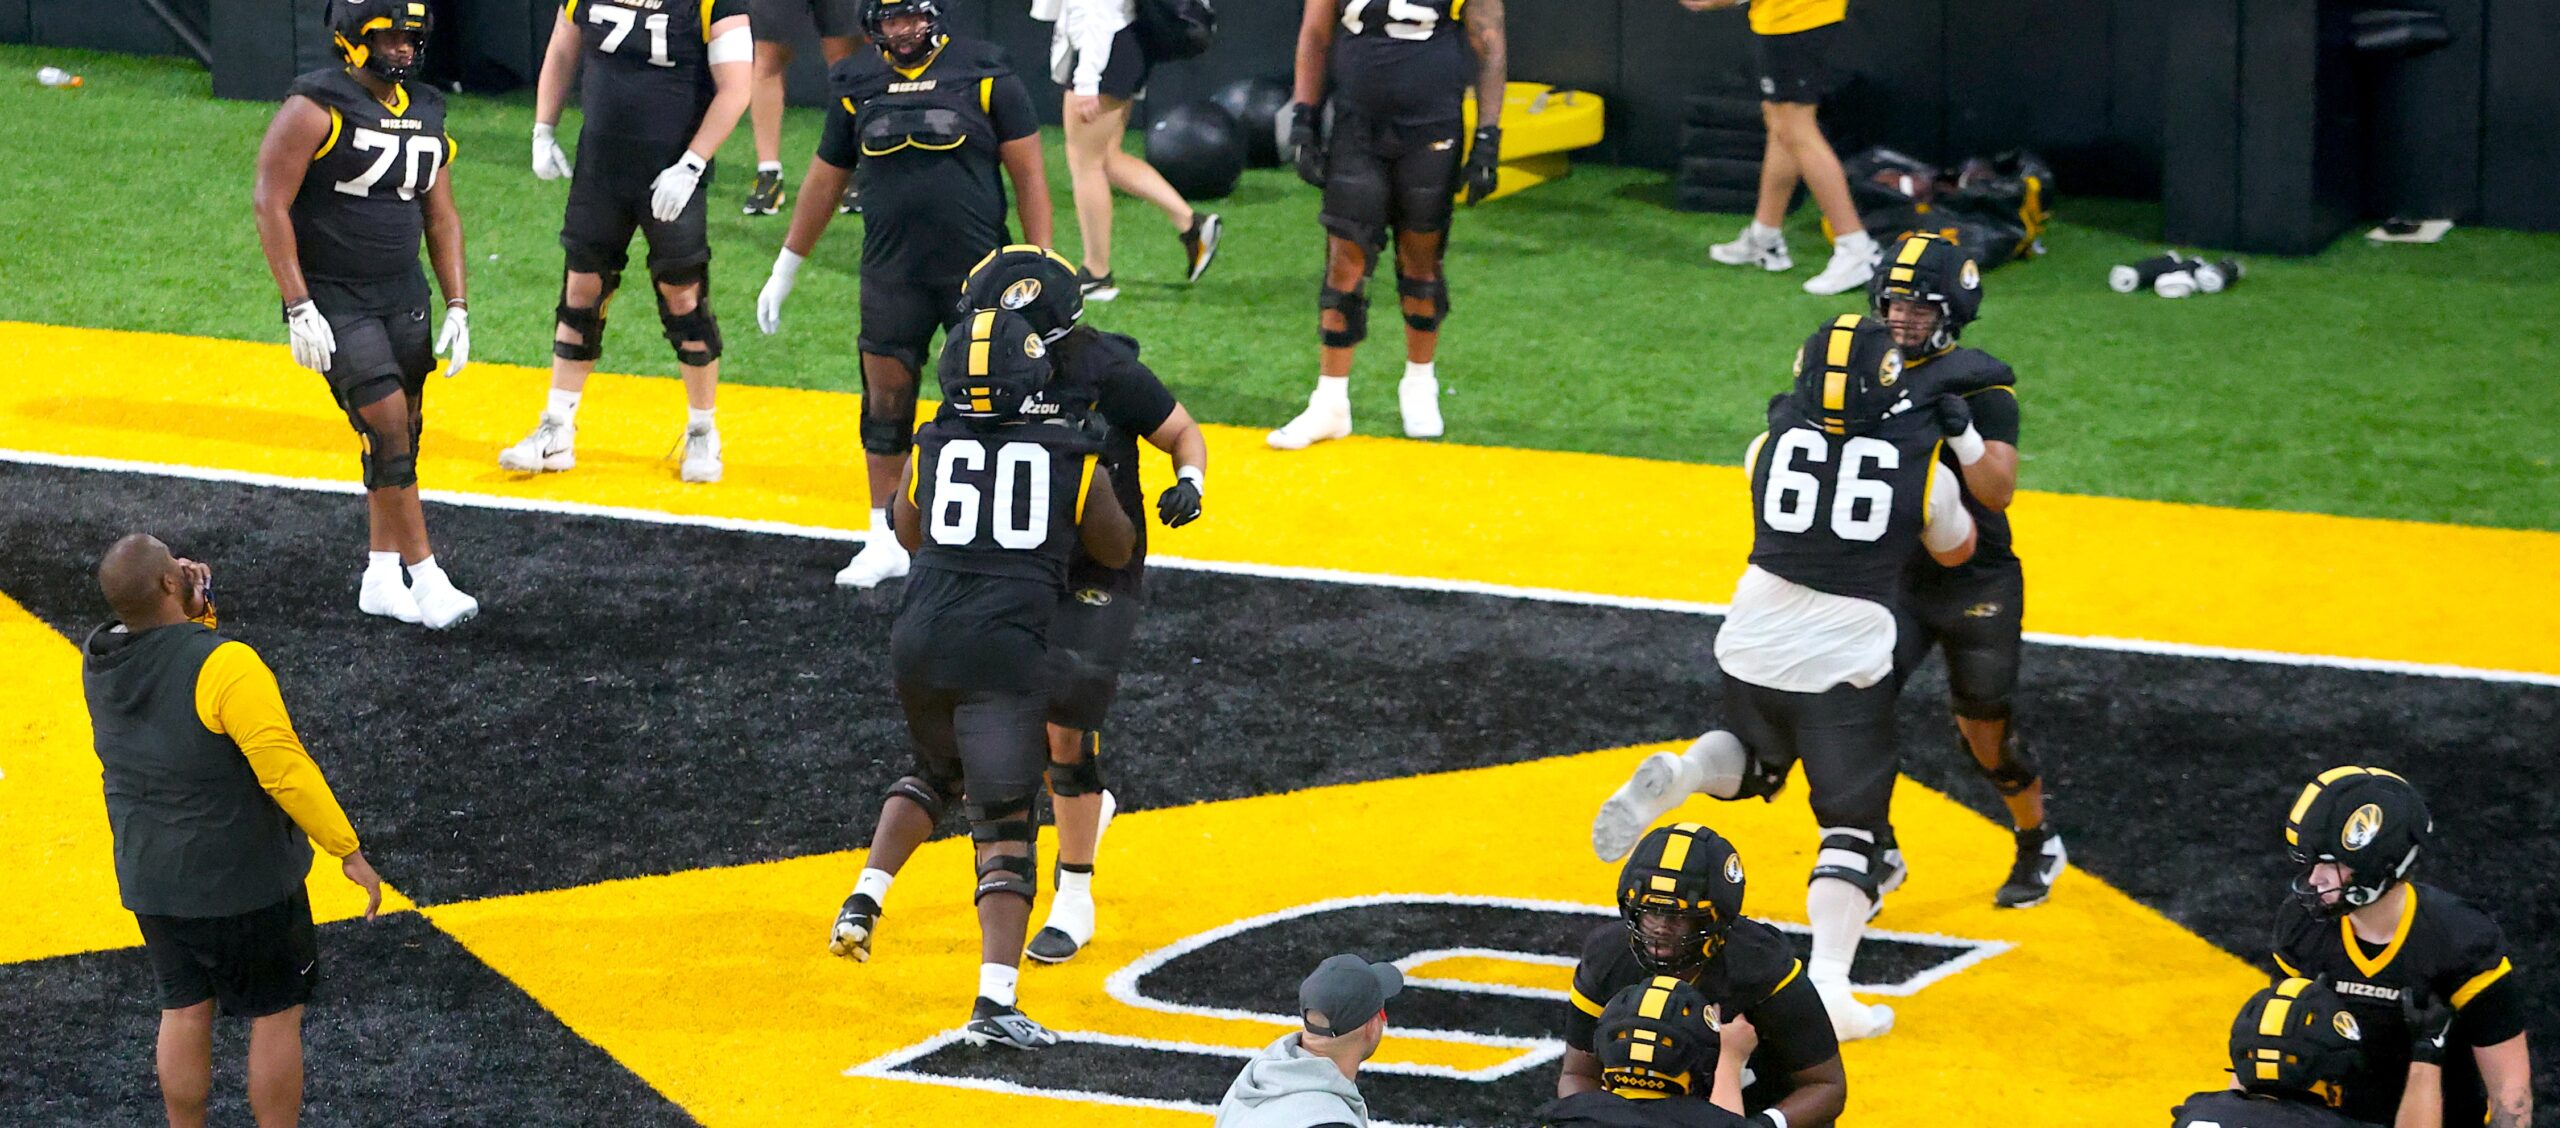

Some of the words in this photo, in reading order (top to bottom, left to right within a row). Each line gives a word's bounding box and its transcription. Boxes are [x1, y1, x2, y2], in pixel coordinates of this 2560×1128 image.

[588, 3, 676, 67] 71
[613, 0, 663, 10] ZZOU
[334, 127, 443, 201] 70
[930, 439, 1051, 549] 60
[1763, 427, 1899, 542] 66
[2335, 980, 2400, 1001] MIZZOU
